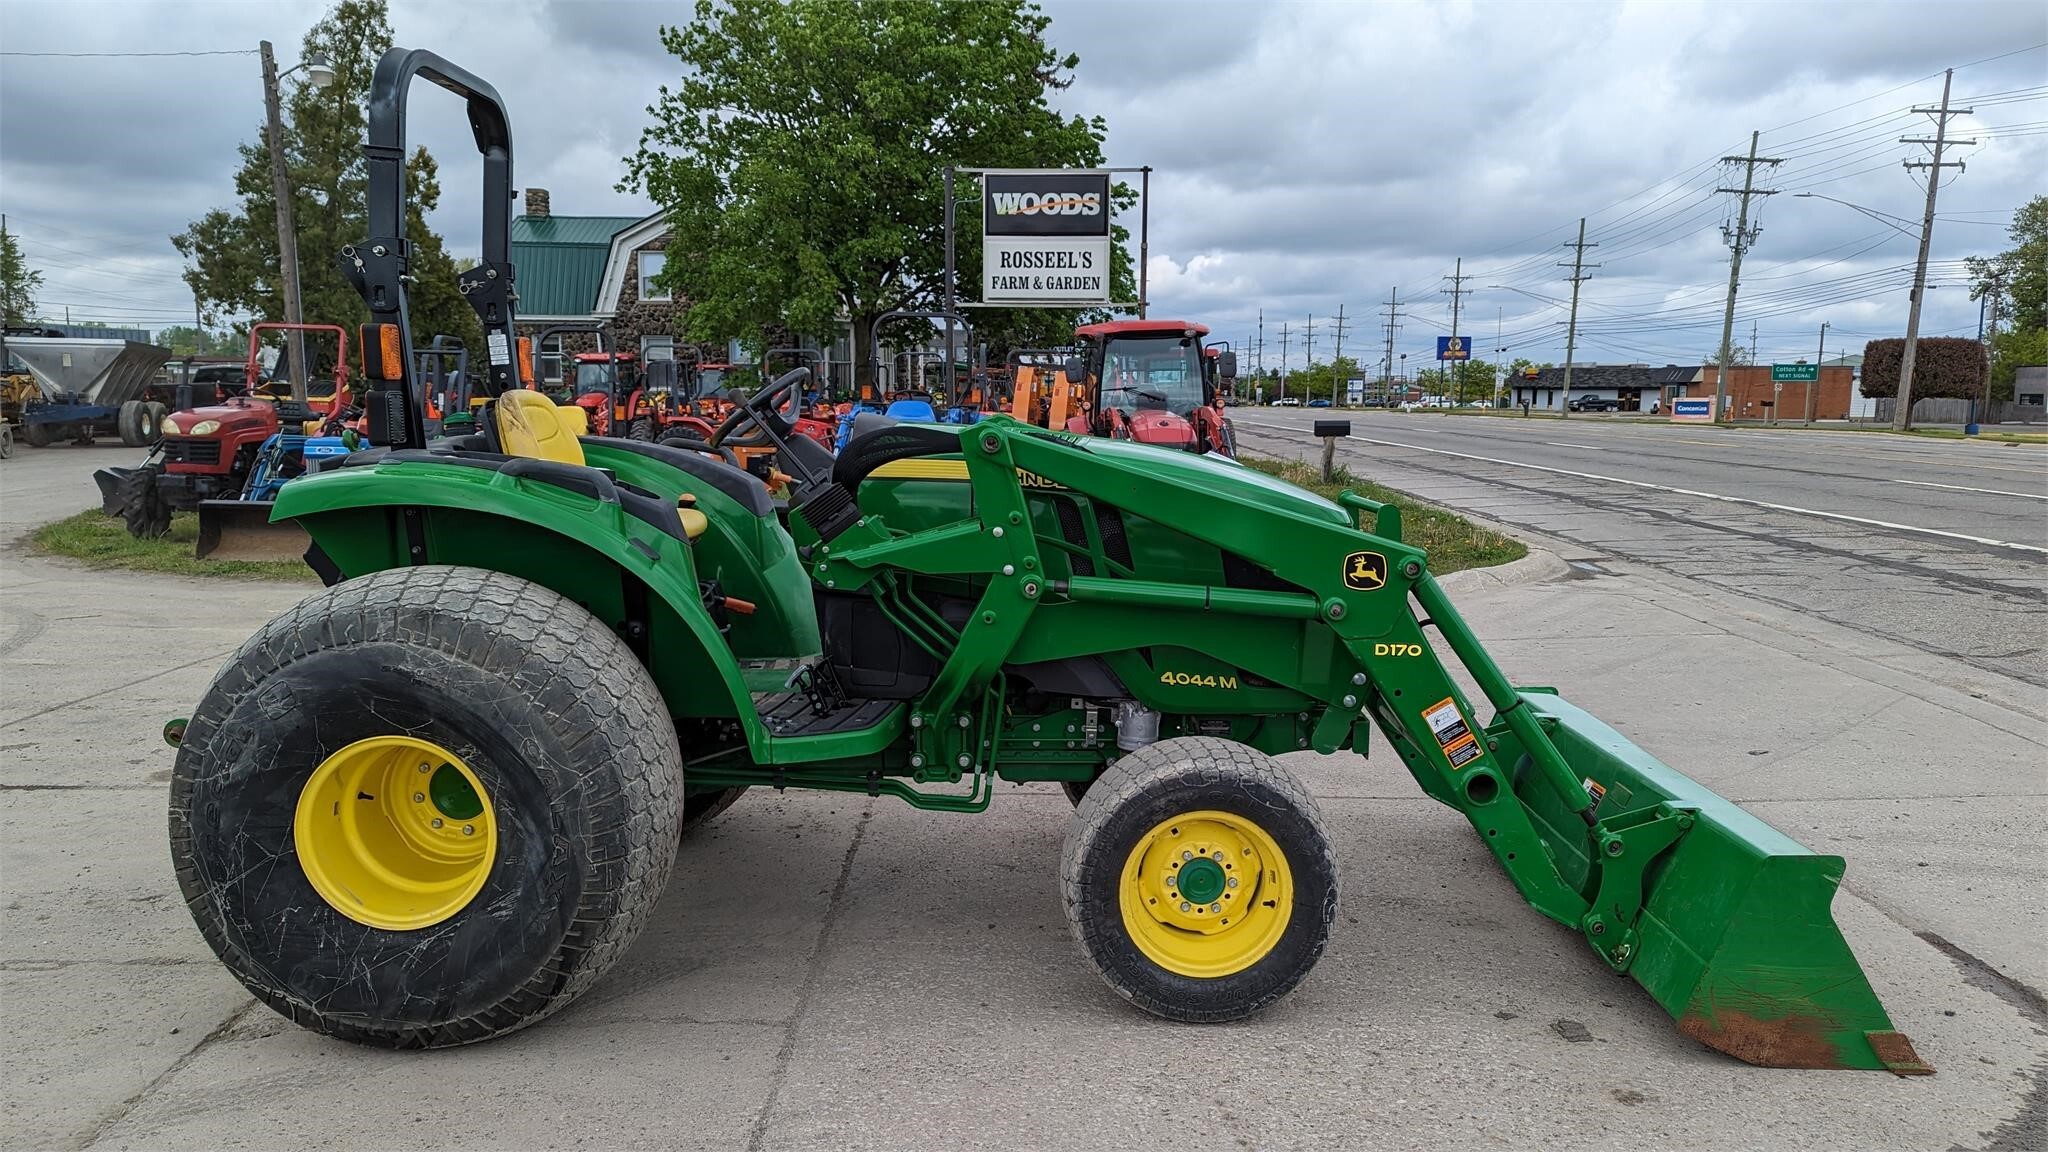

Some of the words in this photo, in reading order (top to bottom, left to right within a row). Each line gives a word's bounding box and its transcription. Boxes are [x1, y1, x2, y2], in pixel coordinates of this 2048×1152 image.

[992, 193, 1101, 216] WOODS
[1000, 251, 1093, 269] ROSSEEL'S
[991, 276, 1030, 290] FARM
[1032, 276, 1043, 290] &
[1046, 276, 1101, 290] GARDEN
[1374, 643, 1422, 657] D170
